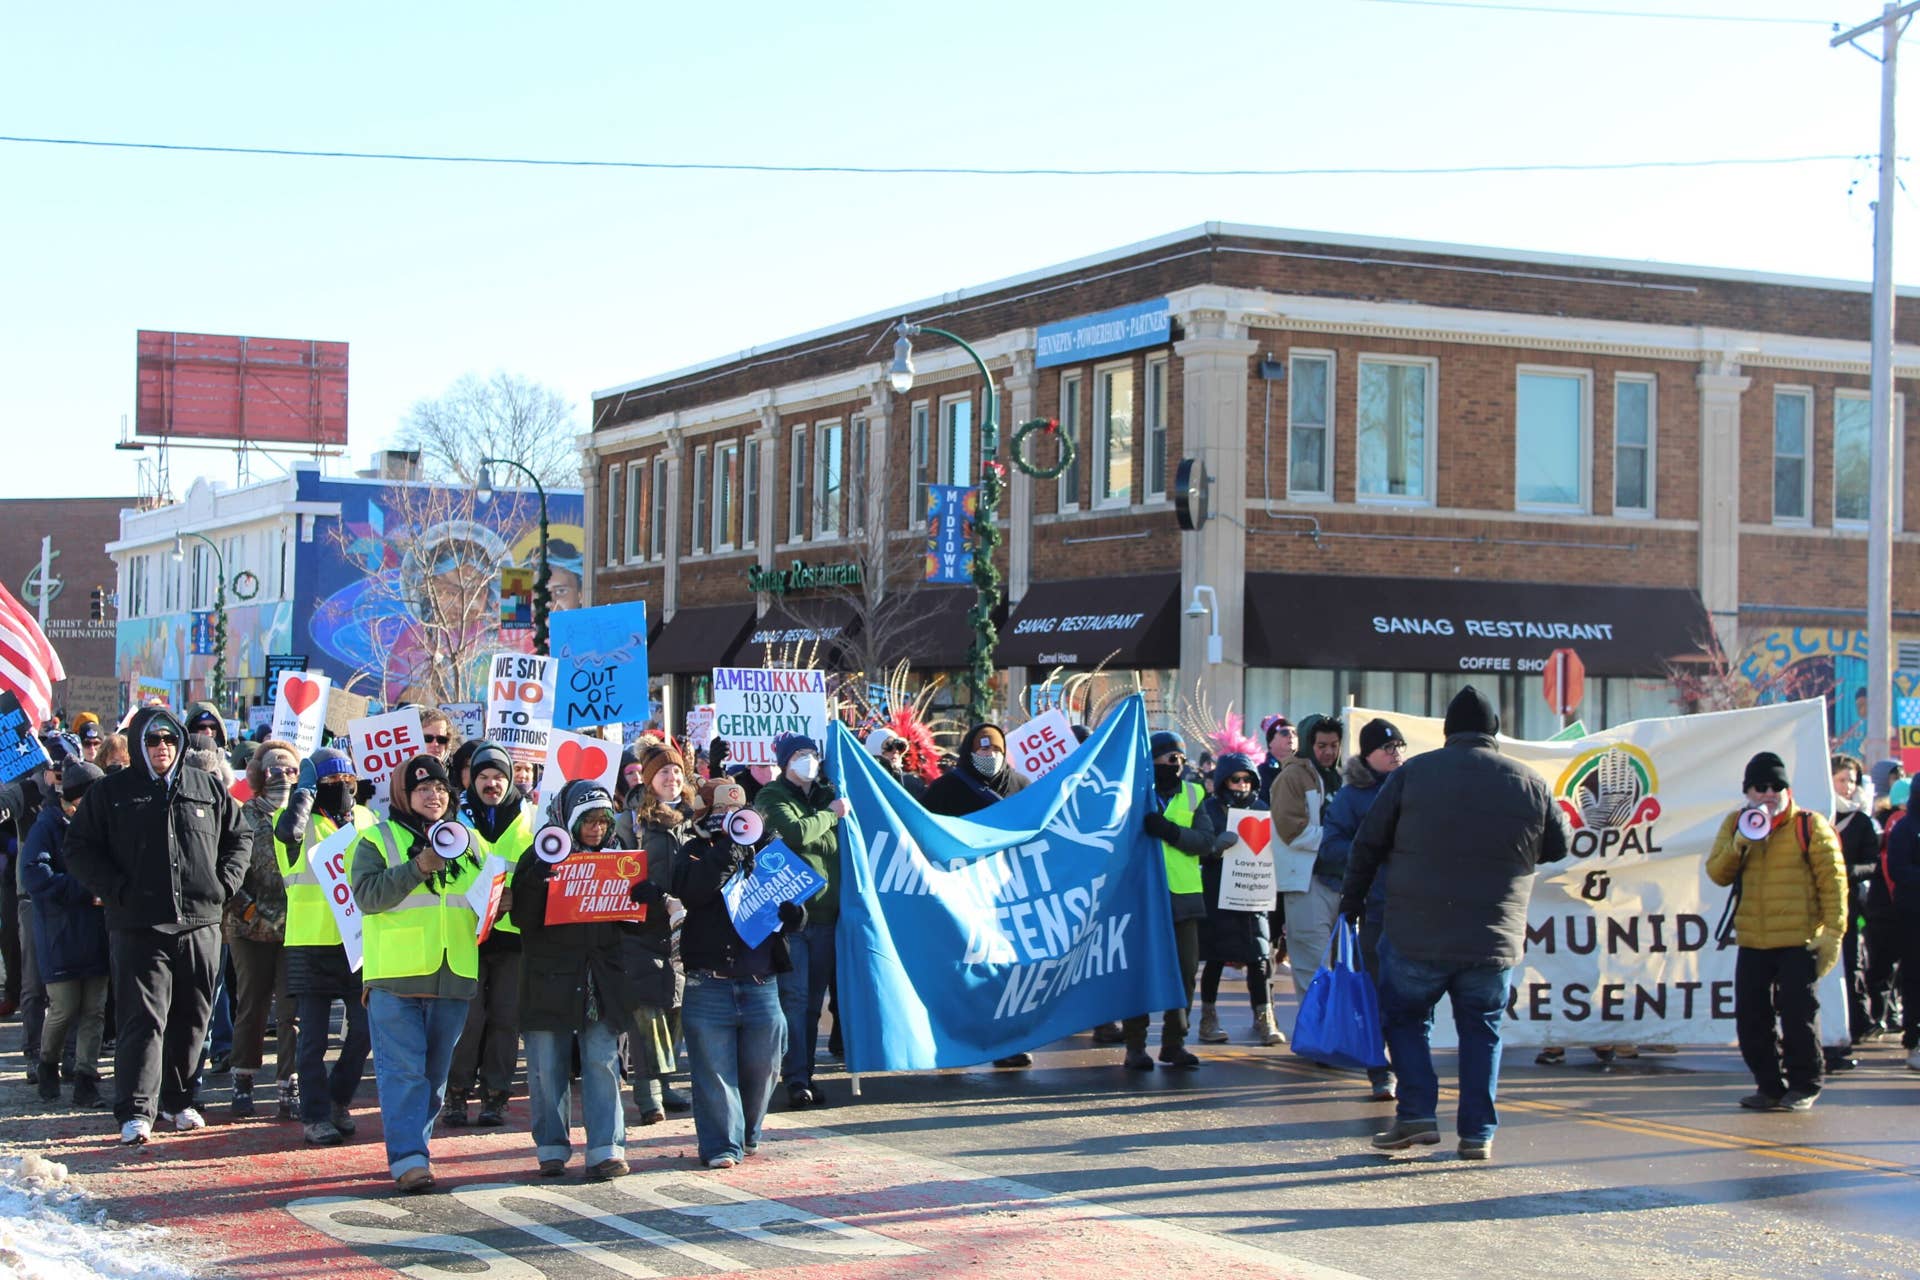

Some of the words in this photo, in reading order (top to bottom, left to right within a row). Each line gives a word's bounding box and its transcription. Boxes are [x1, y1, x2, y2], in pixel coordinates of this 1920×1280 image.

[1076, 319, 1127, 349] POWDERHORN
[1130, 309, 1169, 338] PARTNERS
[944, 490, 957, 578] MIDTOWN
[46, 619, 81, 628] CHRIST
[87, 619, 117, 628] CHUR
[48, 629, 117, 638] INTERNATION
[1014, 617, 1057, 634] SANAG
[1057, 613, 1145, 632] RESTAURANT
[1373, 616, 1455, 636] SANAG
[1465, 619, 1613, 640] RESTAURANT
[751, 630, 783, 644] SANAG
[496, 657, 513, 678] WE
[517, 657, 547, 681] SAY
[1058, 652, 1078, 663] House
[1459, 656, 1511, 670] COFFEE
[570, 666, 618, 692] OUT
[714, 668, 825, 693] AMERIKKKA
[493, 680, 544, 703] NO
[587, 685, 616, 703] OF
[743, 692, 800, 714] 1930'S
[280, 719, 297, 727] Love
[498, 710, 529, 725] TO
[567, 702, 623, 726] MN
[717, 714, 812, 737] GERMANY
[364, 726, 411, 750] ICE
[1019, 725, 1057, 755] ICE
[364, 746, 419, 772] OUT
[1025, 738, 1067, 772] OUT
[373, 774, 385, 783] of
[553, 863, 596, 881] STAND
[1231, 870, 1272, 880] Immigrant
[1235, 859, 1256, 867] Love
[1257, 859, 1273, 868] Your
[564, 880, 600, 897] WITH
[601, 879, 630, 896] OUR
[737, 864, 796, 922] IMMIGRANT
[772, 870, 814, 907] RIGHTS
[1234, 882, 1270, 891] Neighbor
[1581, 870, 1611, 901] &
[993, 913, 1132, 1020] NETWORK
